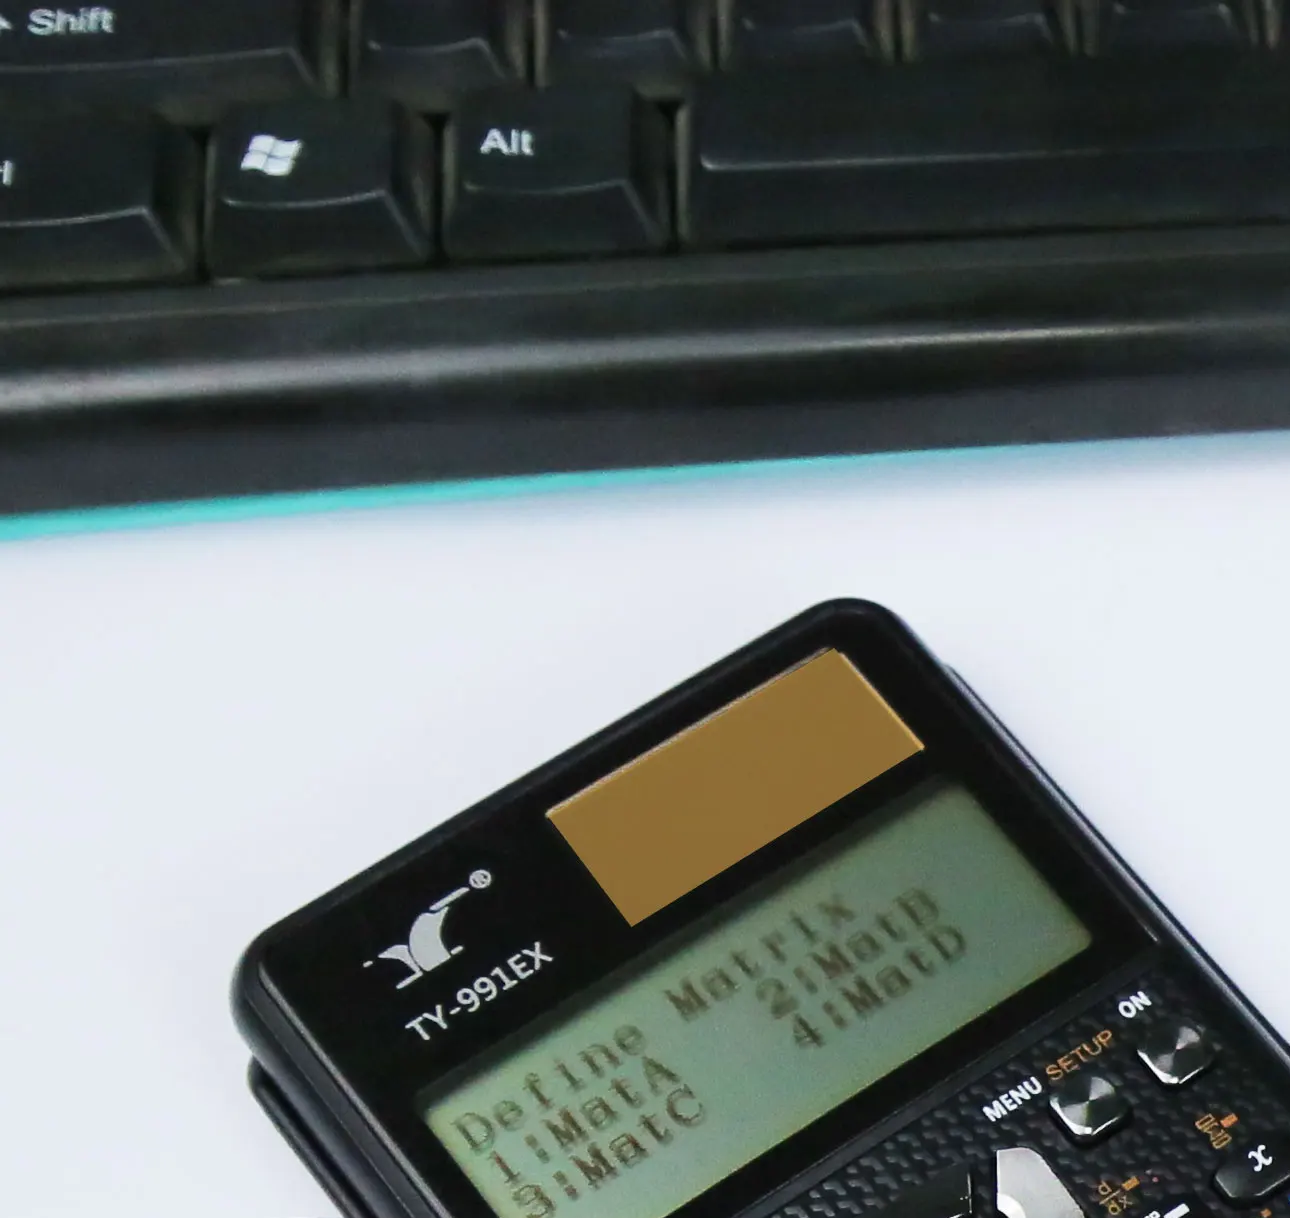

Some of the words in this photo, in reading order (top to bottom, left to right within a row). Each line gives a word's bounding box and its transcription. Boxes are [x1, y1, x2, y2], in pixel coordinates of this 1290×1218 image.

[28, 8, 114, 36] Shift
[480, 128, 534, 157] Alt
[405, 941, 553, 1041] TY-991EX
[1118, 991, 1152, 1018] ON
[451, 1024, 648, 1153] Define
[664, 893, 858, 1022] Matrix
[982, 1076, 1043, 1123] MENU
[1045, 1028, 1113, 1081] SETUP
